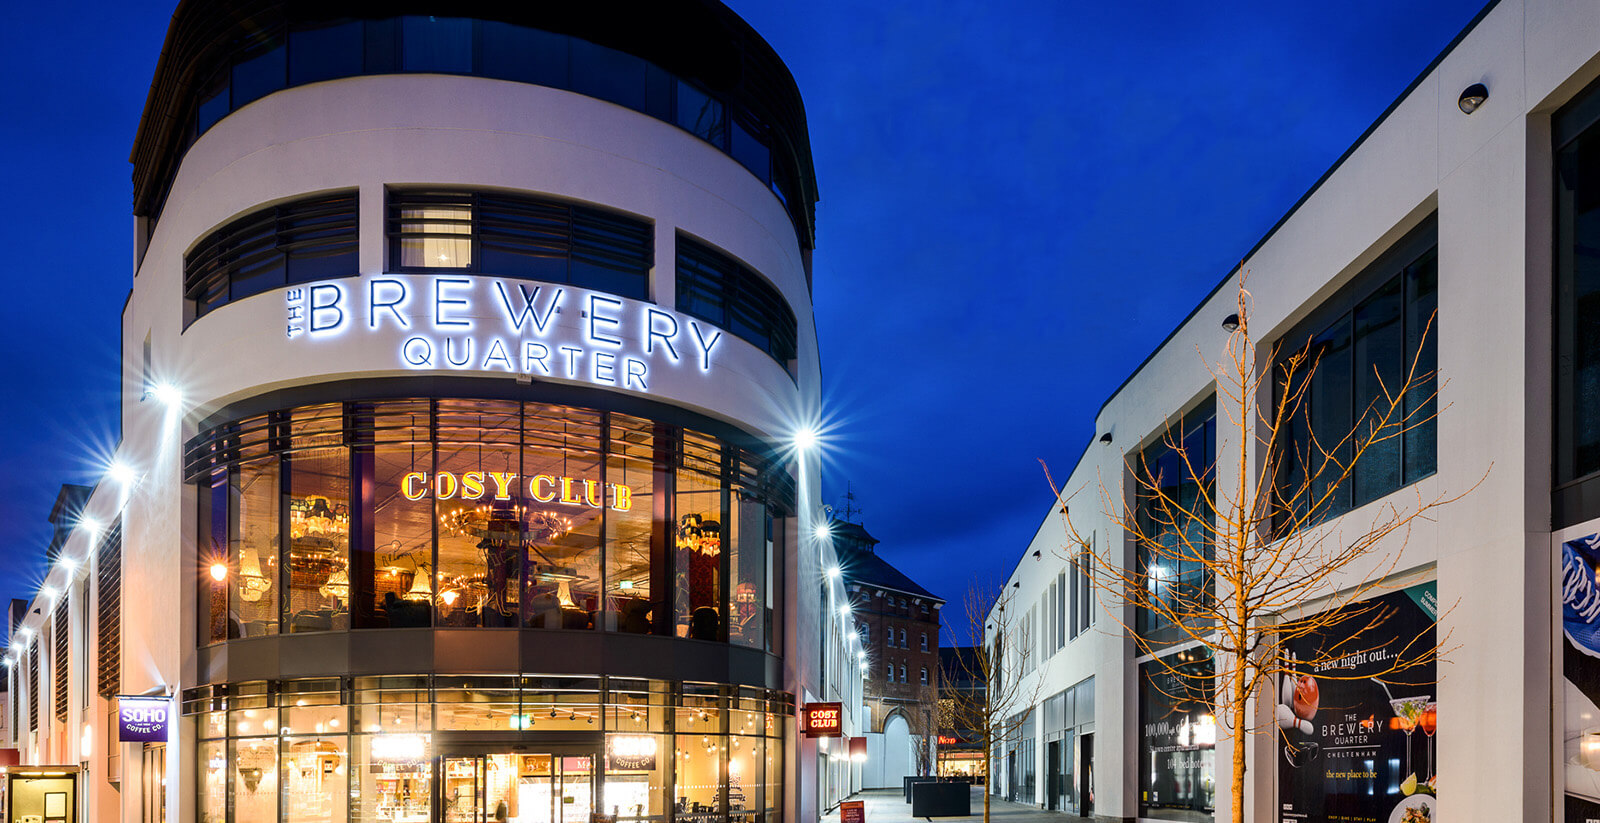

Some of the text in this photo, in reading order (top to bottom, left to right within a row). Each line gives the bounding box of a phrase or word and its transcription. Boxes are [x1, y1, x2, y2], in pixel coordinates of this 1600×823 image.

[287, 288, 304, 337] THE
[310, 278, 721, 370] BREWERY
[403, 337, 648, 389] QUARTER
[401, 471, 633, 512] COSY CLUB
[1313, 663, 1320, 672] a
[1320, 658, 1338, 671] new
[1341, 649, 1367, 670] night
[121, 708, 166, 723] SOHO
[810, 710, 838, 719] COSY
[1344, 713, 1357, 721] THE
[126, 723, 151, 733] COFFEE
[810, 719, 838, 728] CLUB
[1145, 721, 1169, 738] 100,000
[1322, 720, 1384, 737] BREWERY
[1334, 735, 1368, 745] QUARTER
[616, 757, 640, 769] COFFEE
[1326, 769, 1335, 778] the
[1347, 769, 1362, 780] place
[1362, 770, 1369, 778] to
[1369, 769, 1378, 778] be
